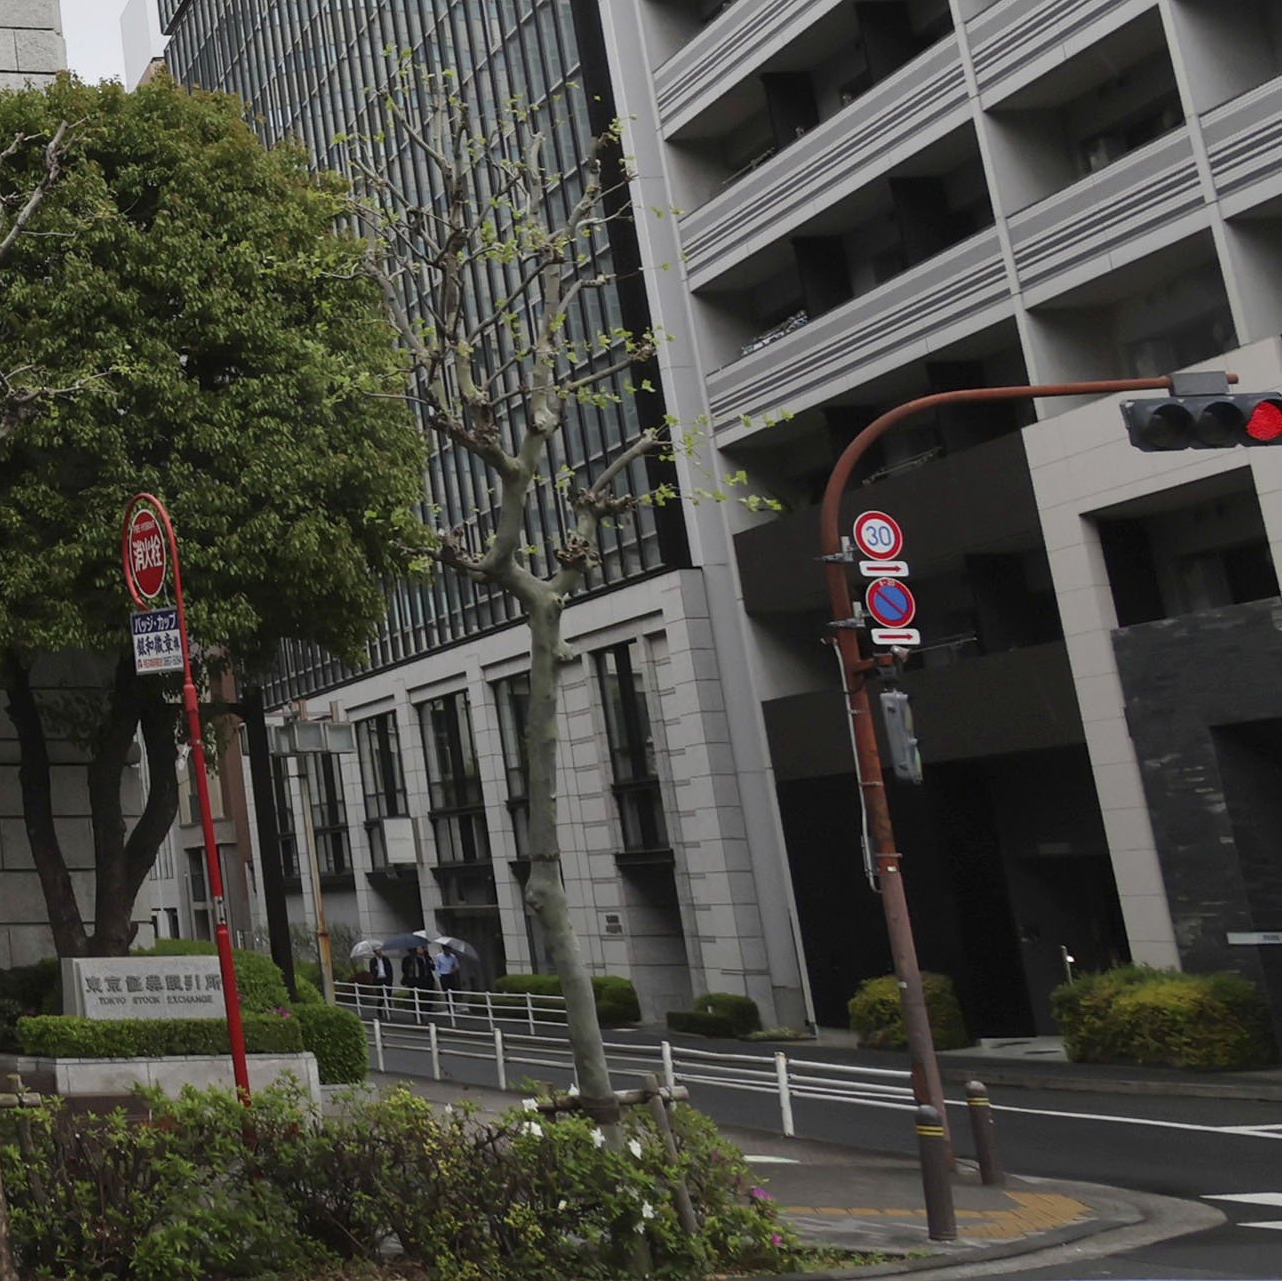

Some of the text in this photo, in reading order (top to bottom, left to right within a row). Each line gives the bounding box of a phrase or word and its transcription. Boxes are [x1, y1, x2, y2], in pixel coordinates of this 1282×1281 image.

[865, 525, 892, 547] 30
[132, 534, 163, 572] 消火栓
[99, 994, 213, 1005] TOKYO STOCK EXCHANGE
